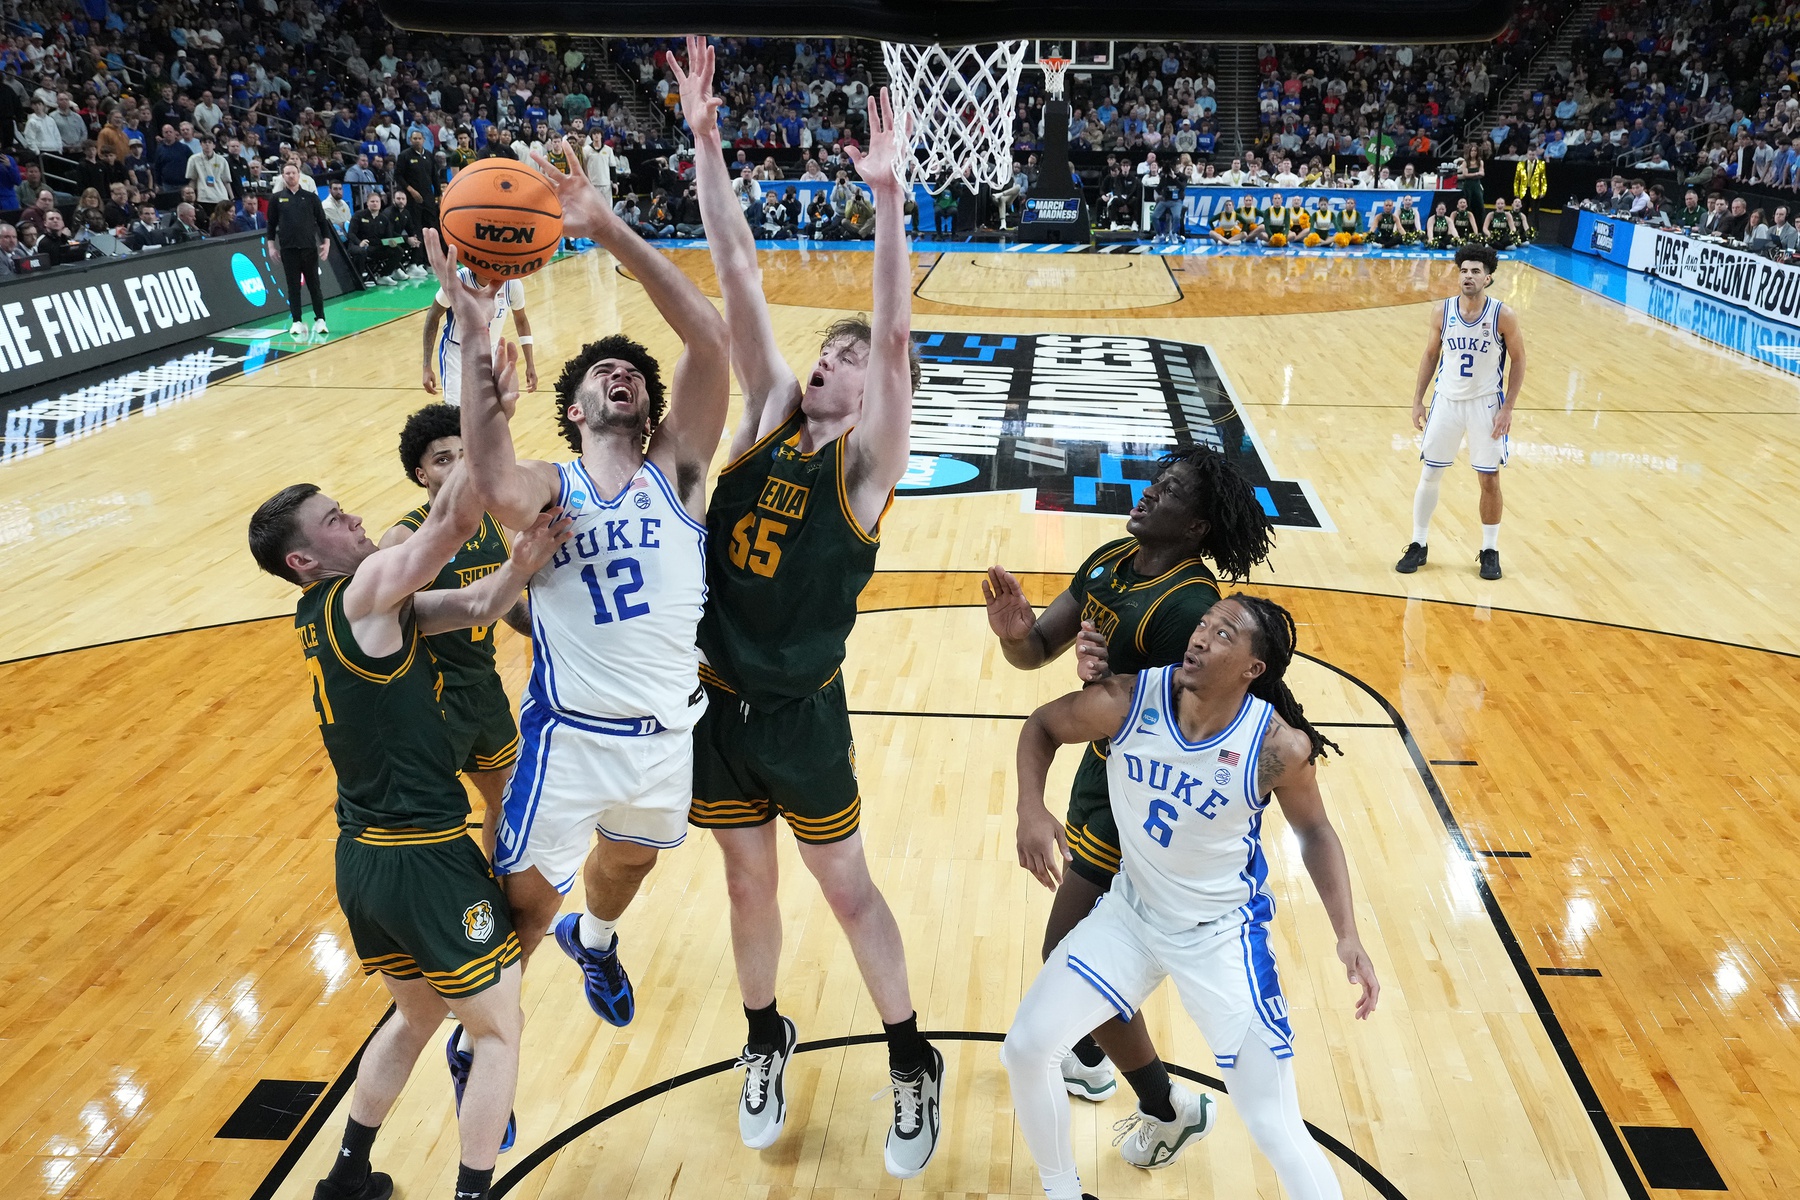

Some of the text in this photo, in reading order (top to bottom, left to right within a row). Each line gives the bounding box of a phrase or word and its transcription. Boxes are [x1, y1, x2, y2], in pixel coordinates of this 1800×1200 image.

[1035, 200, 1065, 210] MARCH
[1038, 209, 1078, 219] MADNESS
[474, 222, 535, 244] NCAA
[239, 276, 266, 296] NCAA
[463, 250, 543, 276] Wilson
[1654, 234, 1689, 279] FIRST
[1696, 247, 1757, 302] SECOND
[31, 283, 136, 358] FINAL
[123, 266, 211, 334] FOUR
[1447, 337, 1491, 354] DUKE
[1460, 353, 1474, 378] 2
[908, 362, 1014, 456] MARCH
[1024, 335, 1179, 446] MADNESS
[553, 518, 661, 569] DUKE
[580, 557, 651, 626] 12
[1123, 752, 1230, 820] DUKE
[1143, 798, 1178, 848] 6
